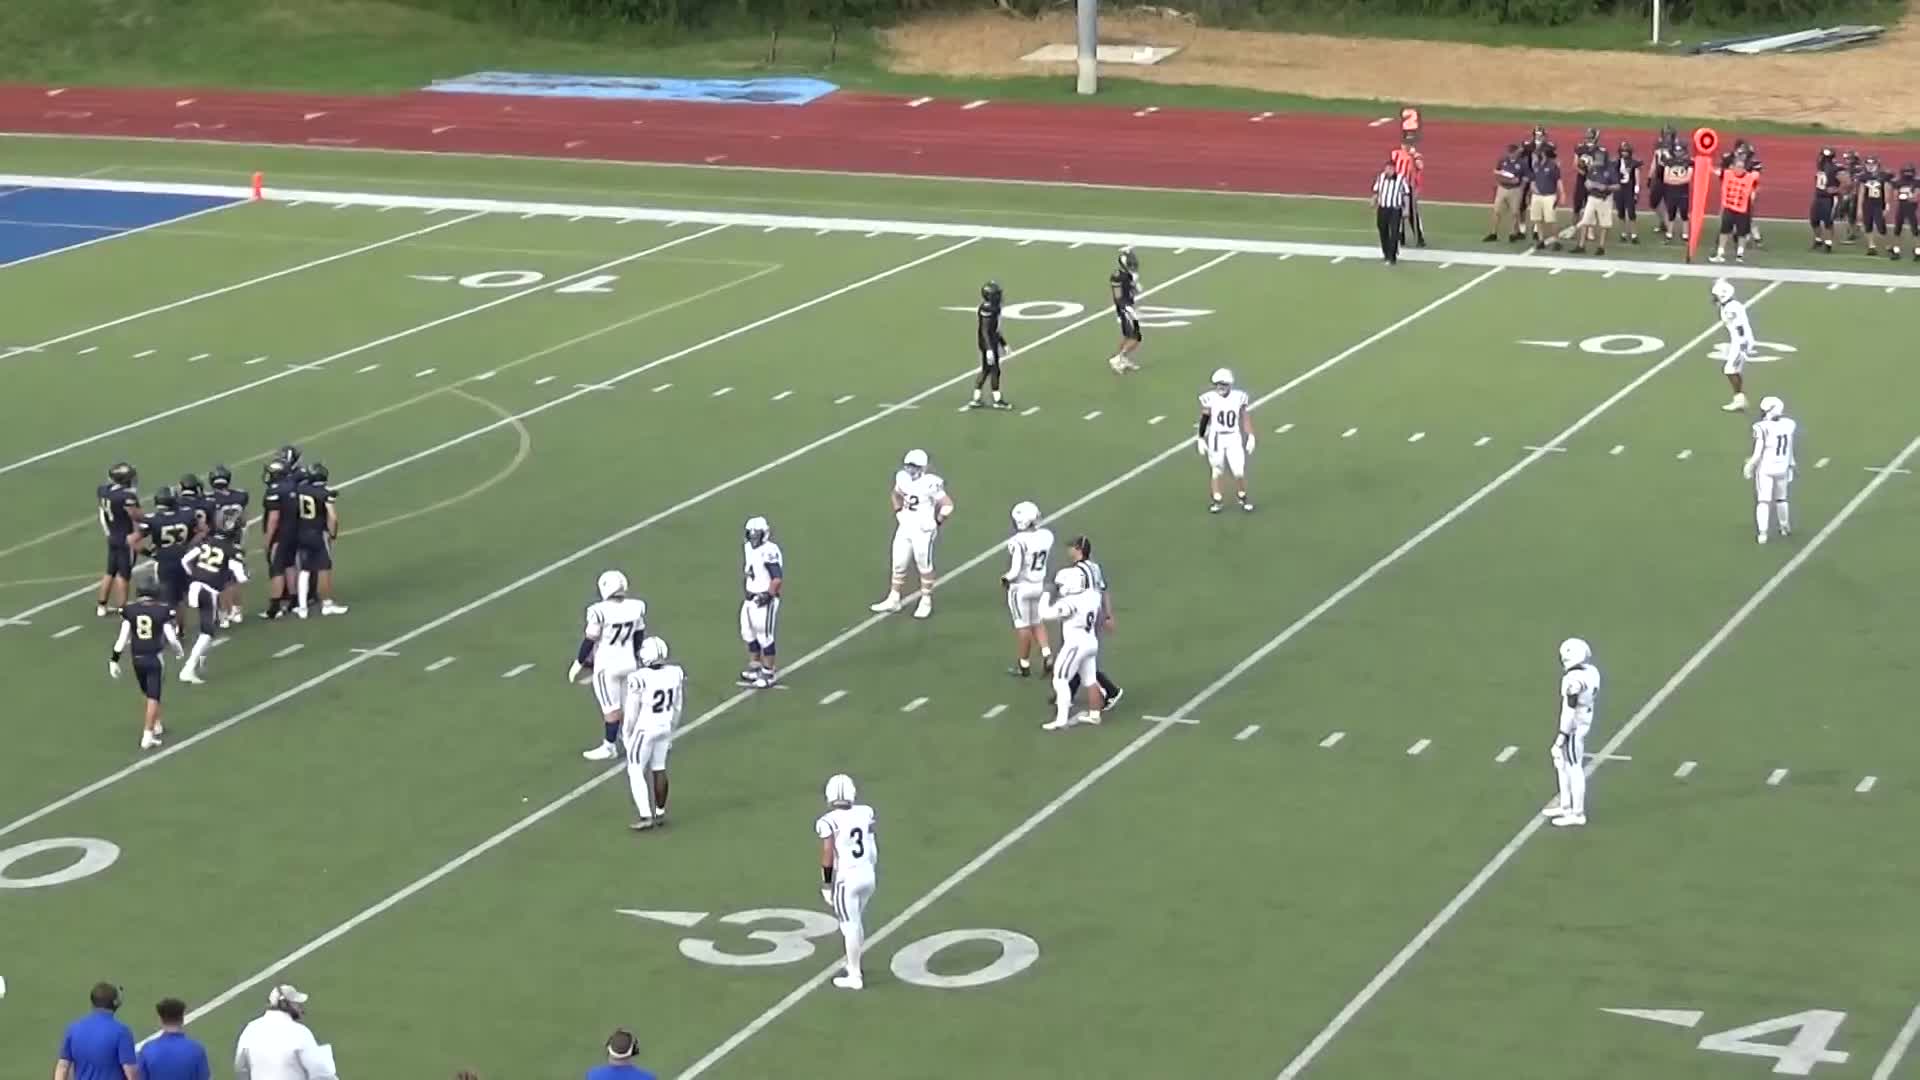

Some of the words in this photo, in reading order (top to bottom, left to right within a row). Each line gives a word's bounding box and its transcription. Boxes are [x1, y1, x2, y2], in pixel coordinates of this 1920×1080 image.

[1402, 108, 1418, 130] 2
[1216, 410, 1237, 428] 40
[1775, 434, 1789, 456] 11
[161, 523, 189, 548] 53
[196, 543, 225, 573] 22
[136, 615, 153, 640] 8
[611, 622, 635, 647] 77
[652, 689, 674, 713] 21
[849, 827, 866, 859] 3
[1696, 1009, 1850, 1076] 4
